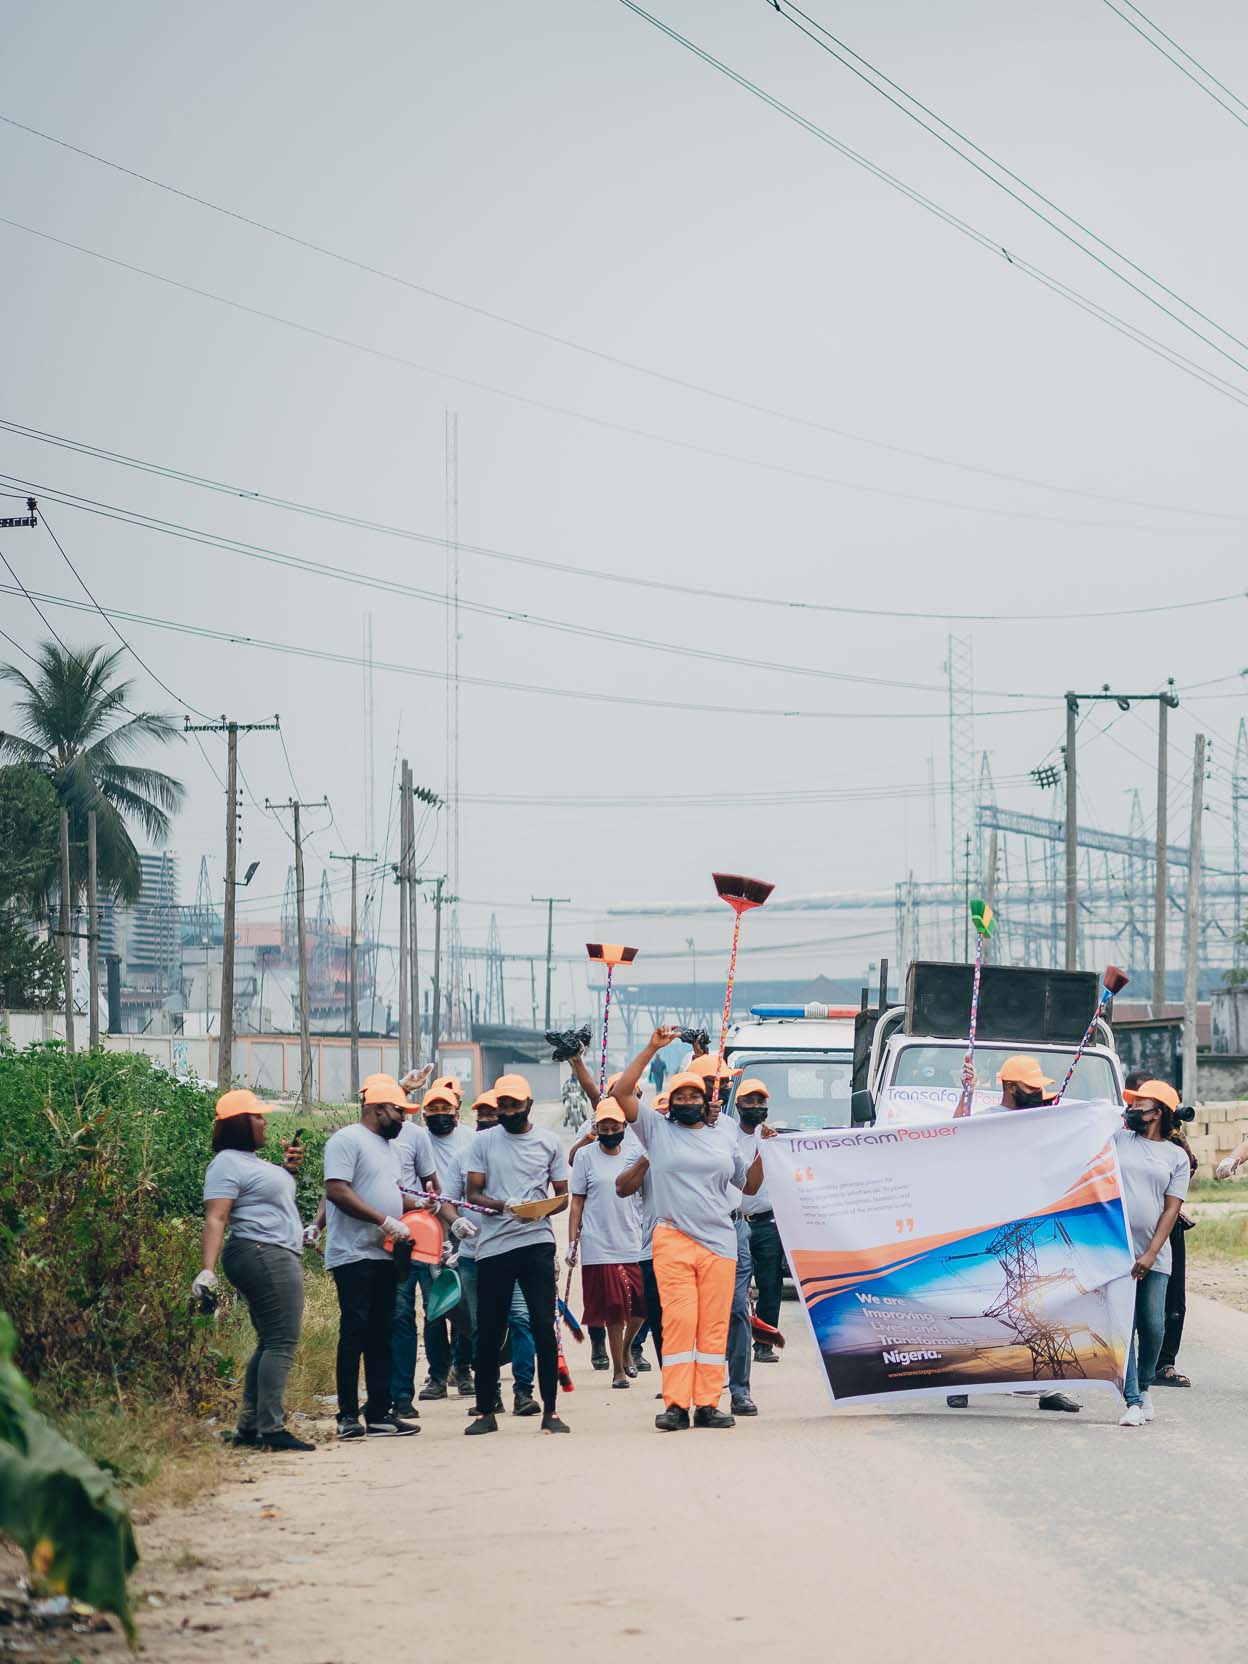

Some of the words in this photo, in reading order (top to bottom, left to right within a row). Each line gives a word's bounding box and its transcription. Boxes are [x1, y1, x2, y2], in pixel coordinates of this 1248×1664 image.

[855, 1292, 881, 1305] We
[883, 1297, 907, 1306] are
[863, 1307, 936, 1323] Improving
[911, 1323, 941, 1334] and
[878, 1334, 975, 1346] Transforming
[882, 1348, 942, 1366] Nigeria.
